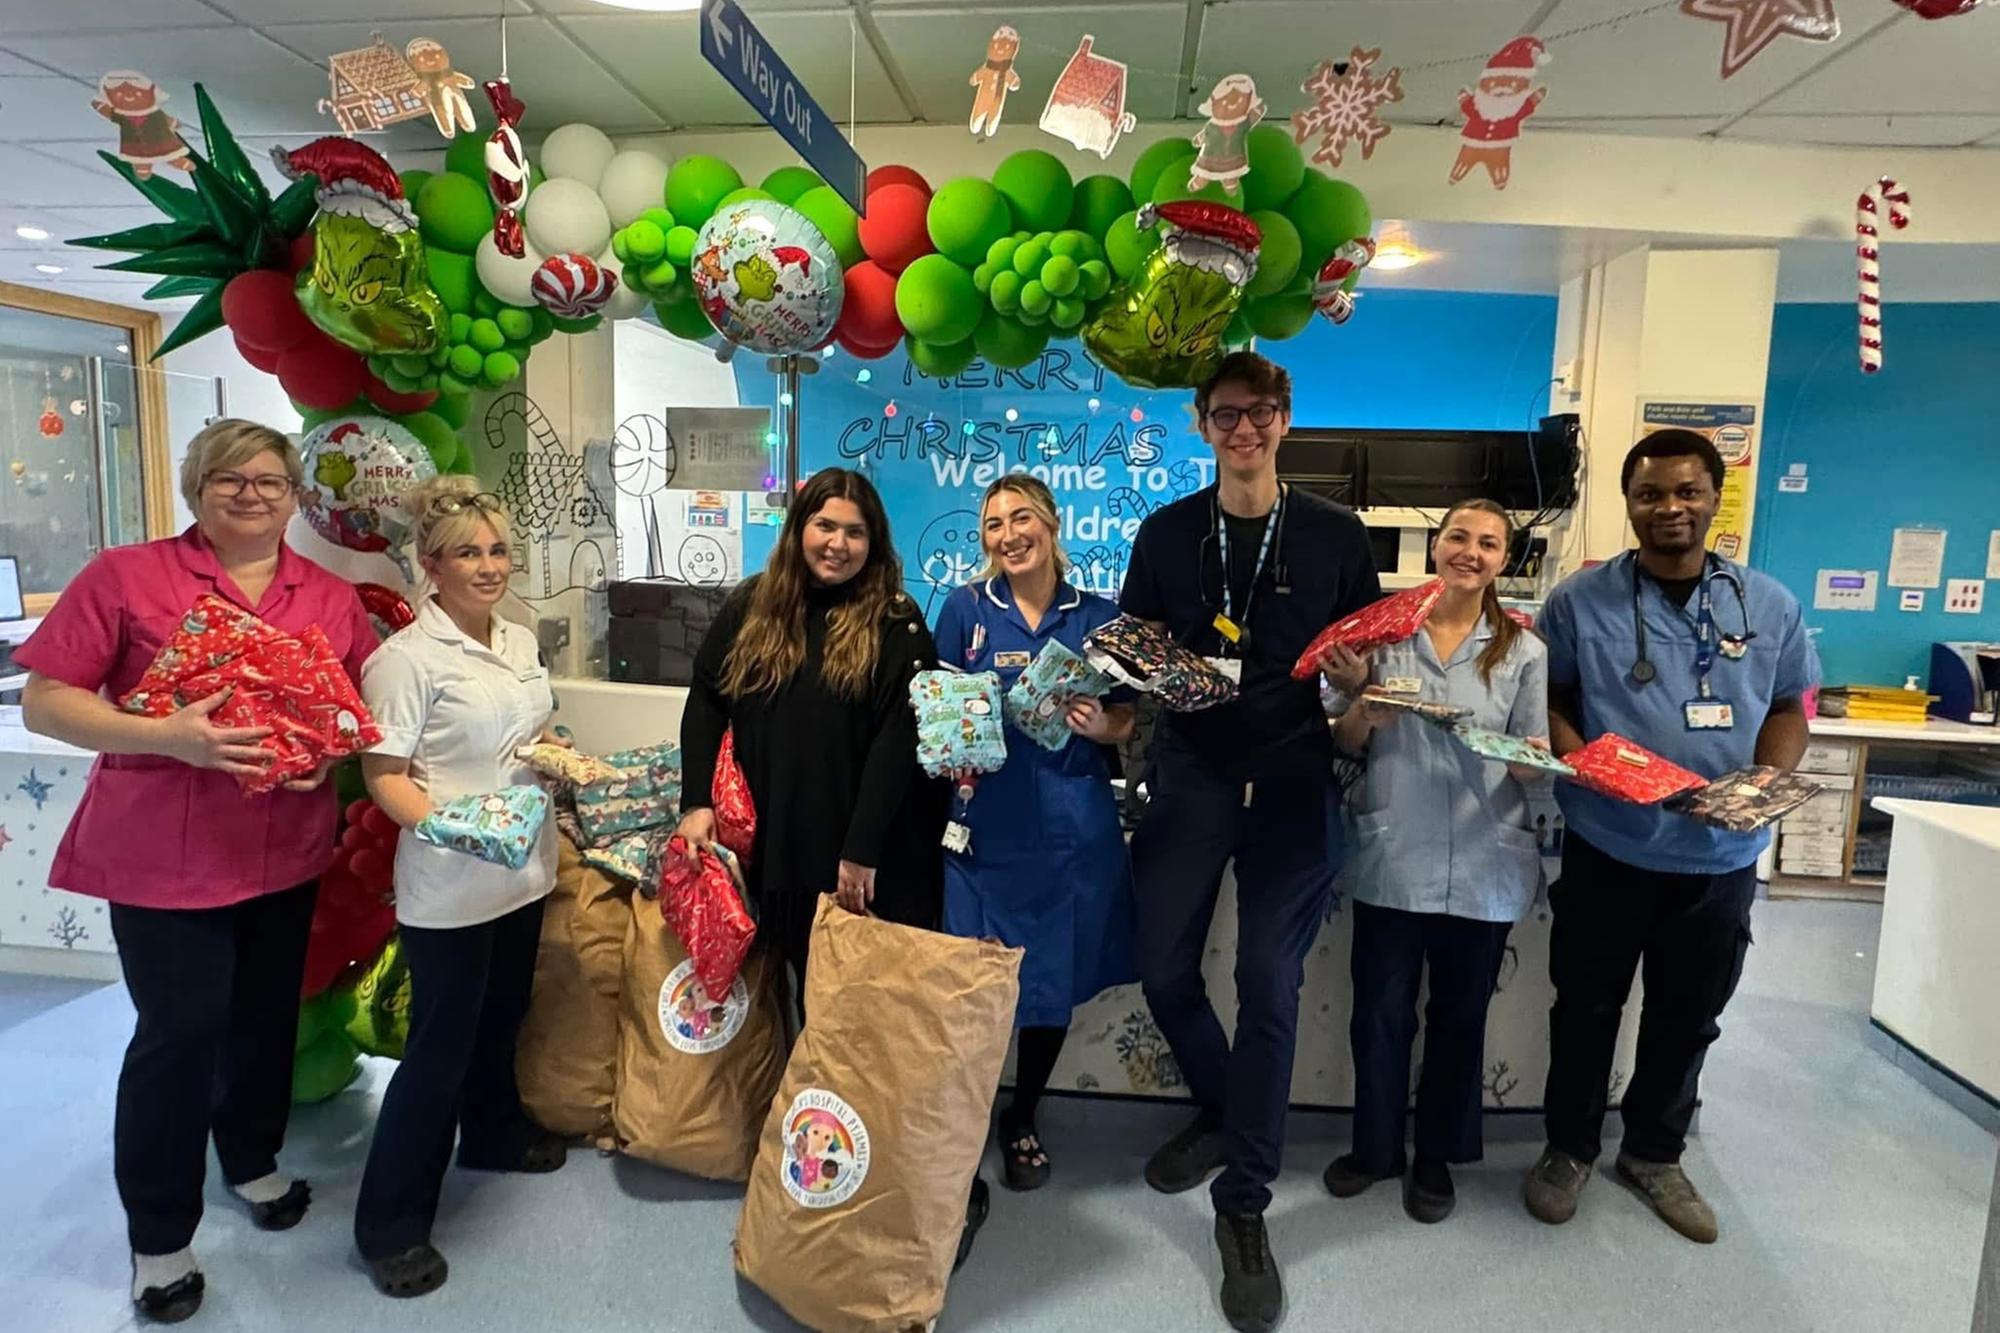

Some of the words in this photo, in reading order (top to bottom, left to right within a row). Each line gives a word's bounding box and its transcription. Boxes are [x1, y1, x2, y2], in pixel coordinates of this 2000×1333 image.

[739, 25, 780, 117] Way
[784, 81, 812, 145] Out
[838, 416, 1168, 467] CHRISTMAS
[364, 465, 413, 480] MERRY
[930, 452, 1107, 490] Welome
